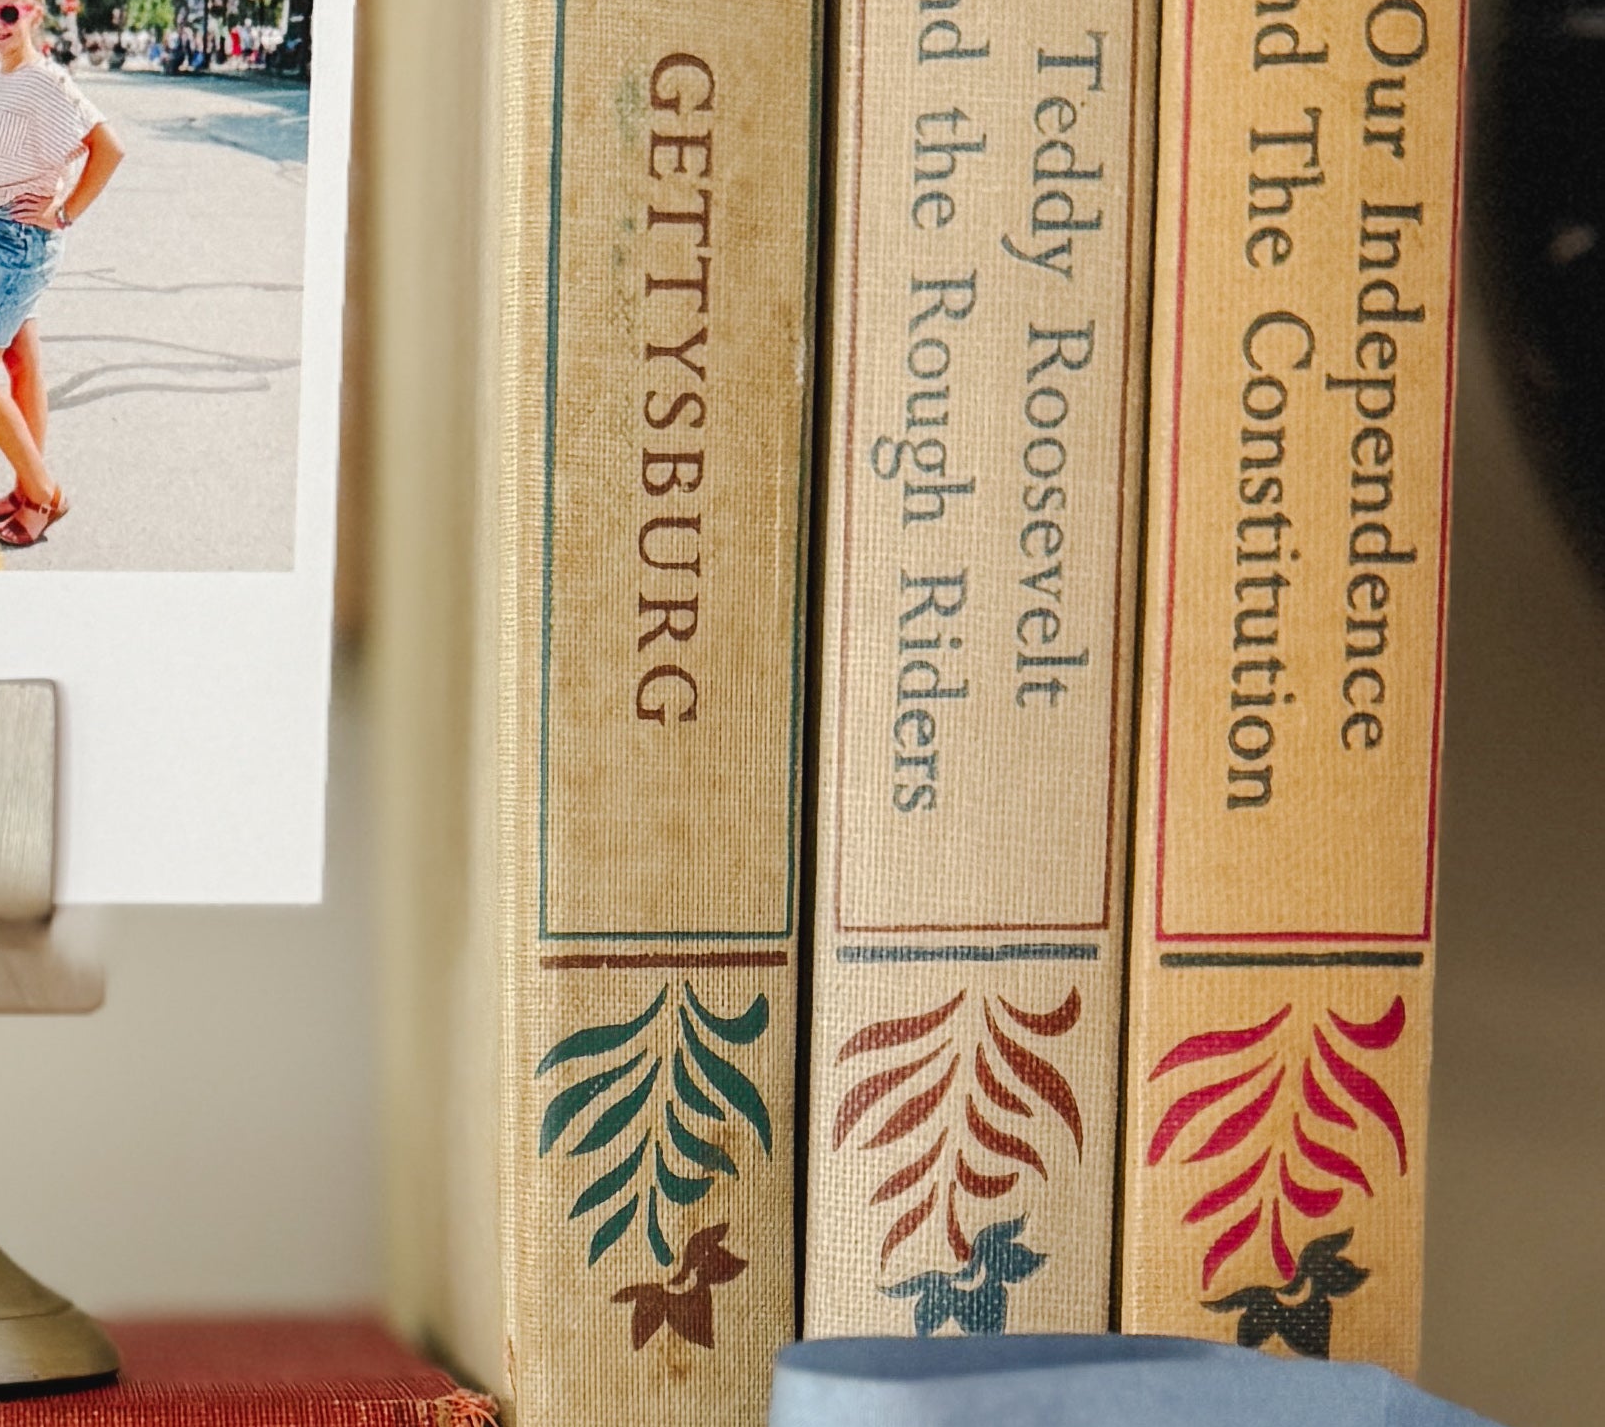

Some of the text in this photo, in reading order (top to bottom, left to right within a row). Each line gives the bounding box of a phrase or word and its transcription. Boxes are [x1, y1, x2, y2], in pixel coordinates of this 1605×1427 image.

[911, 106, 987, 229] the
[1246, 107, 1325, 267] The
[635, 52, 715, 725] GETTYSBURG
[871, 269, 978, 527] Rough
[1001, 30, 1105, 708] Teddy Roosevelt
[1326, 200, 1424, 752] Independence
[893, 569, 969, 812] Riders
[1227, 310, 1316, 810] Constitution
